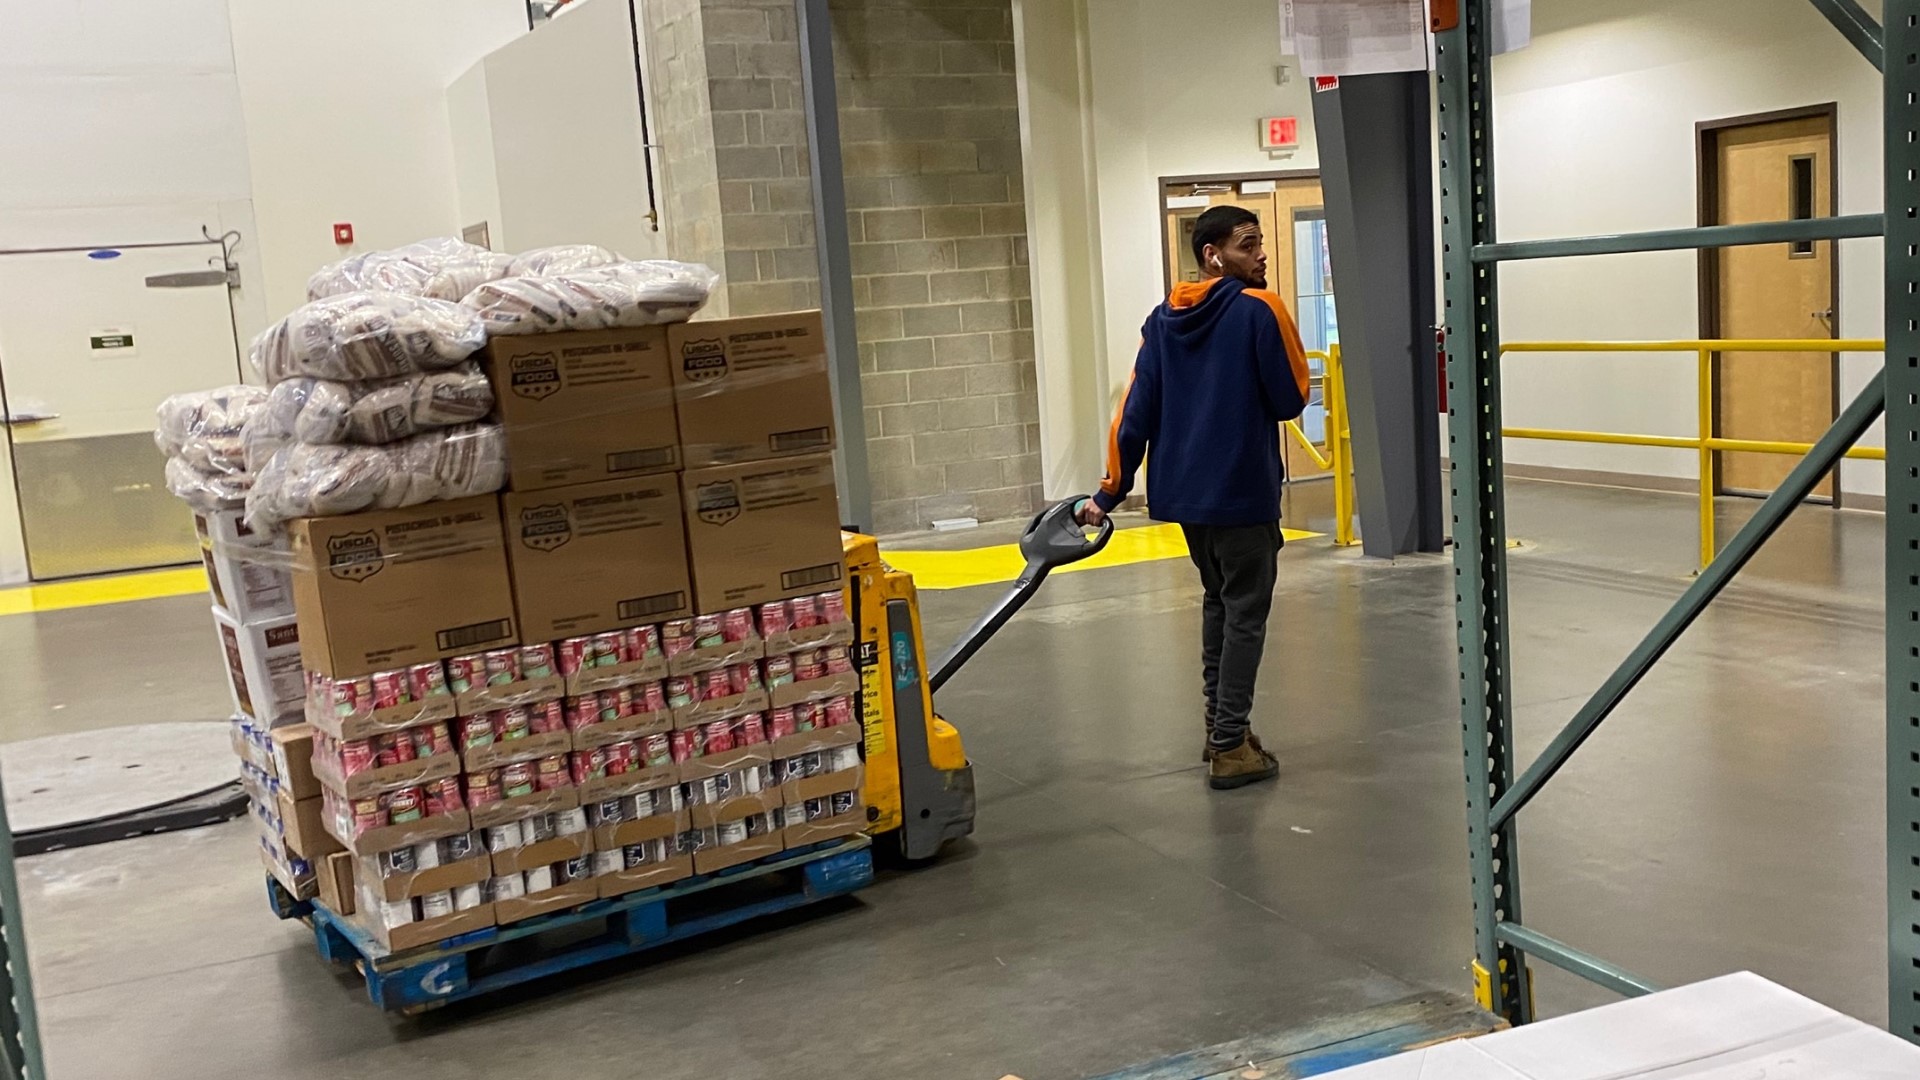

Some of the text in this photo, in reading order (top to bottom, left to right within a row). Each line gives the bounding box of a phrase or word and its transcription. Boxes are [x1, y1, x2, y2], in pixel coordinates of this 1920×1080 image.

[687, 344, 721, 354] USDA
[513, 358, 552, 369] USDA
[688, 358, 723, 368] FOOD
[516, 372, 555, 383] FOOD
[524, 509, 563, 521] USDA
[527, 524, 565, 534] FOOD
[332, 537, 375, 550] USDA
[268, 628, 299, 641] Sant
[863, 691, 878, 699] vice
[864, 710, 880, 718] ntals
